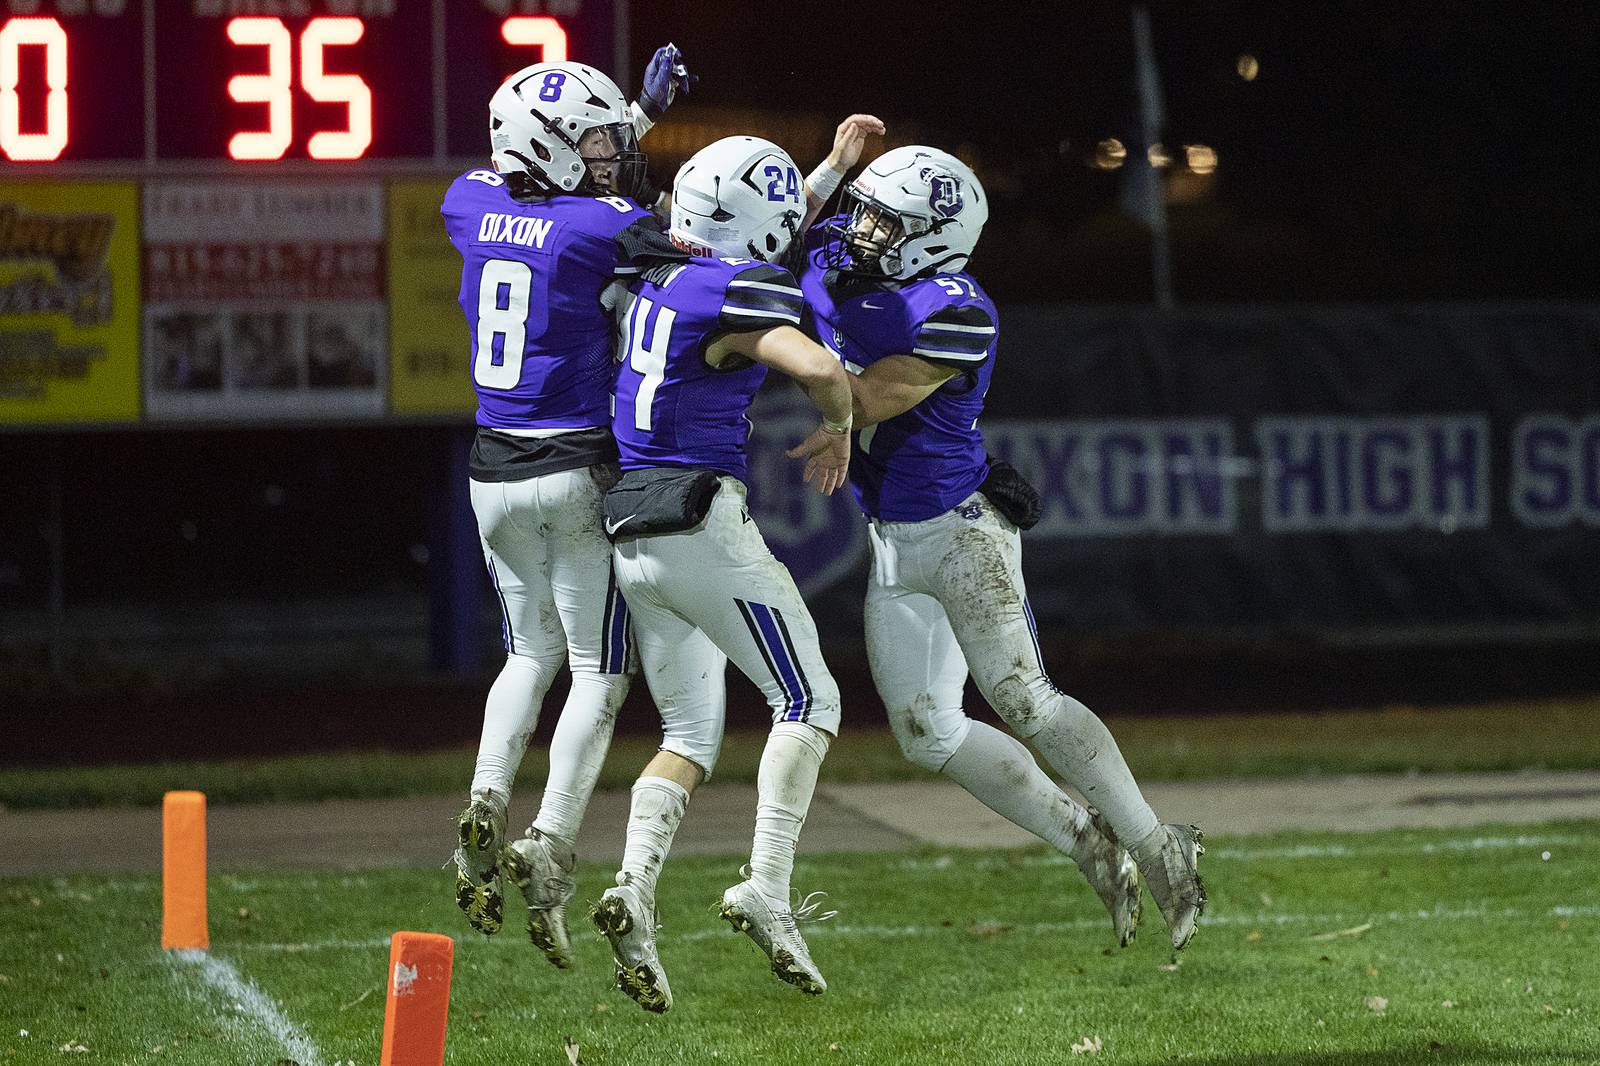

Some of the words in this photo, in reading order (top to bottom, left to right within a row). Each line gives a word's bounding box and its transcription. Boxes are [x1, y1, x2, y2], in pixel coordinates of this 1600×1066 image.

[227, 17, 372, 161] 35
[539, 73, 566, 102] 8
[466, 170, 504, 187] 8
[764, 166, 799, 203] 24
[478, 212, 554, 249] DIXON
[474, 258, 532, 390] 8
[1268, 423, 1482, 520] HIGH
